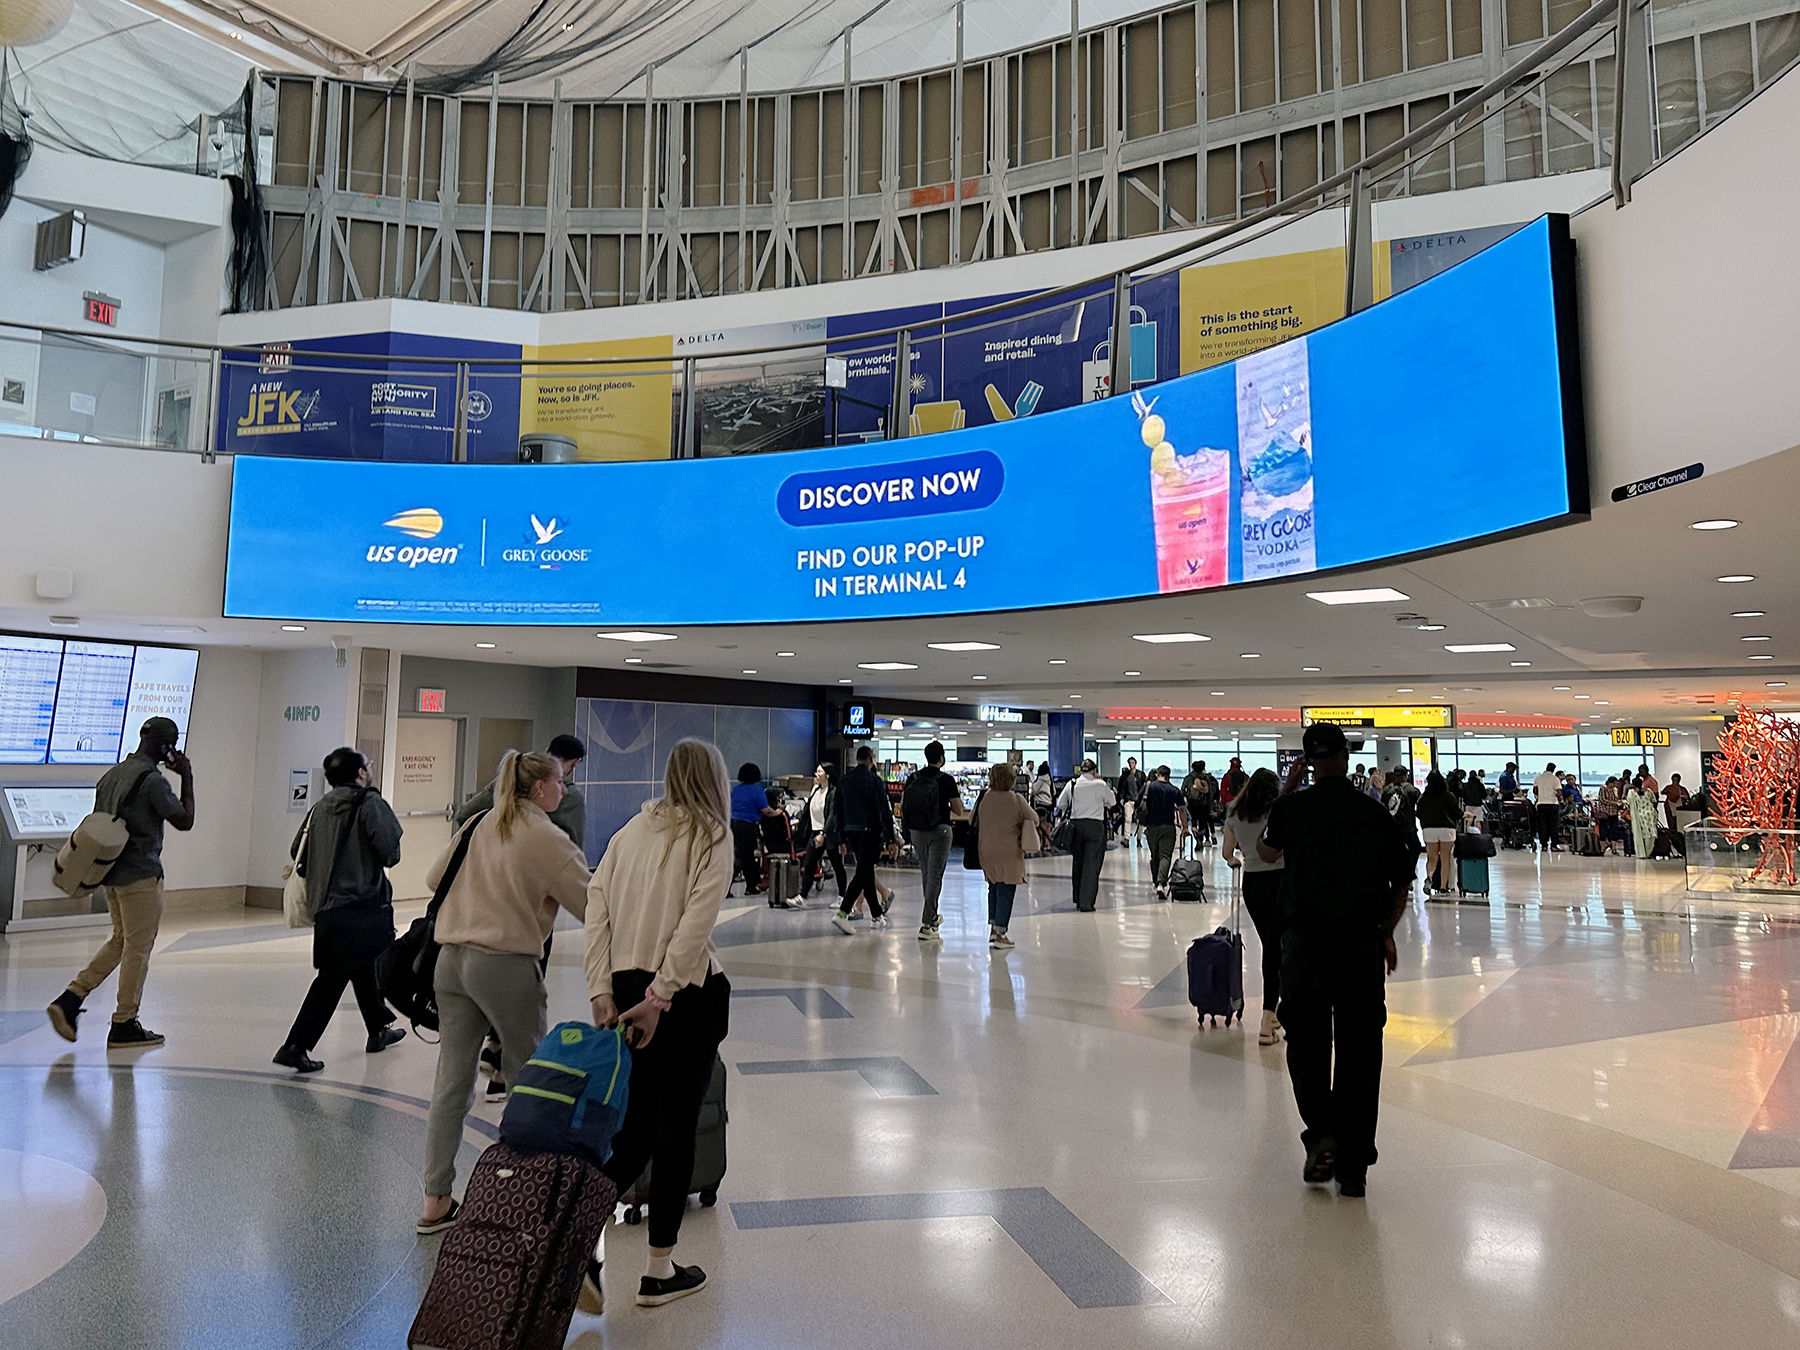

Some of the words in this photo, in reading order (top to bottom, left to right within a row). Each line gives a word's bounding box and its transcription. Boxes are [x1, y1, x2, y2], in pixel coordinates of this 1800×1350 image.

[1412, 234, 1466, 250] DELTA
[89, 299, 115, 325] EXIT
[1200, 314, 1224, 325] This
[1227, 312, 1237, 322] is
[1239, 310, 1260, 320] the
[1262, 305, 1293, 317] start
[1200, 326, 1212, 337] of
[1215, 318, 1278, 336] something
[1280, 316, 1303, 328] big.
[688, 333, 725, 344] DELTA
[984, 337, 1028, 352] Inspired
[1030, 333, 1063, 346] dining
[1200, 343, 1223, 351] We're
[1224, 335, 1277, 348] transforming
[984, 348, 1004, 363] and
[1006, 347, 1037, 360] retail.
[1200, 351, 1216, 359] into
[848, 358, 863, 367] ew
[847, 365, 890, 378] erminals.
[250, 383, 257, 393] A
[260, 381, 283, 393] NEW
[371, 382, 397, 391] PORT
[538, 386, 565, 395] You're
[566, 385, 577, 393] so
[578, 382, 602, 394] going
[603, 381, 635, 392] places.
[1095, 376, 1103, 389] I
[371, 389, 429, 400] AUTHORITY
[538, 396, 559, 404] Now,
[572, 394, 580, 402] is
[582, 393, 600, 402] JFK.
[238, 390, 302, 427] JFK
[1637, 481, 1657, 493] Clear
[1657, 469, 1688, 487] Channel
[799, 477, 915, 511] DISCOVER
[922, 468, 982, 498] NOW
[797, 548, 846, 570] FIND
[852, 544, 898, 567] OUR
[904, 535, 985, 563] POP-UP
[1257, 538, 1299, 556] VODKA
[366, 545, 395, 563] us
[397, 544, 458, 569] open
[502, 549, 537, 562] GREY
[540, 549, 589, 562] GOOSE
[815, 576, 837, 598] IN
[842, 569, 947, 597] TERMINAL
[952, 567, 967, 589] 4
[134, 682, 155, 691] SAFE
[156, 683, 191, 693] TRAVELS
[138, 694, 161, 702] FROM
[162, 695, 183, 703] YOUR
[421, 691, 444, 712] EXIT
[130, 705, 164, 713] FRIENDS
[165, 706, 176, 714] AT
[843, 724, 871, 735] Hudson
[1616, 730, 1631, 744] B20
[1645, 730, 1664, 744] B20
[402, 755, 437, 763] EMERGENCY
